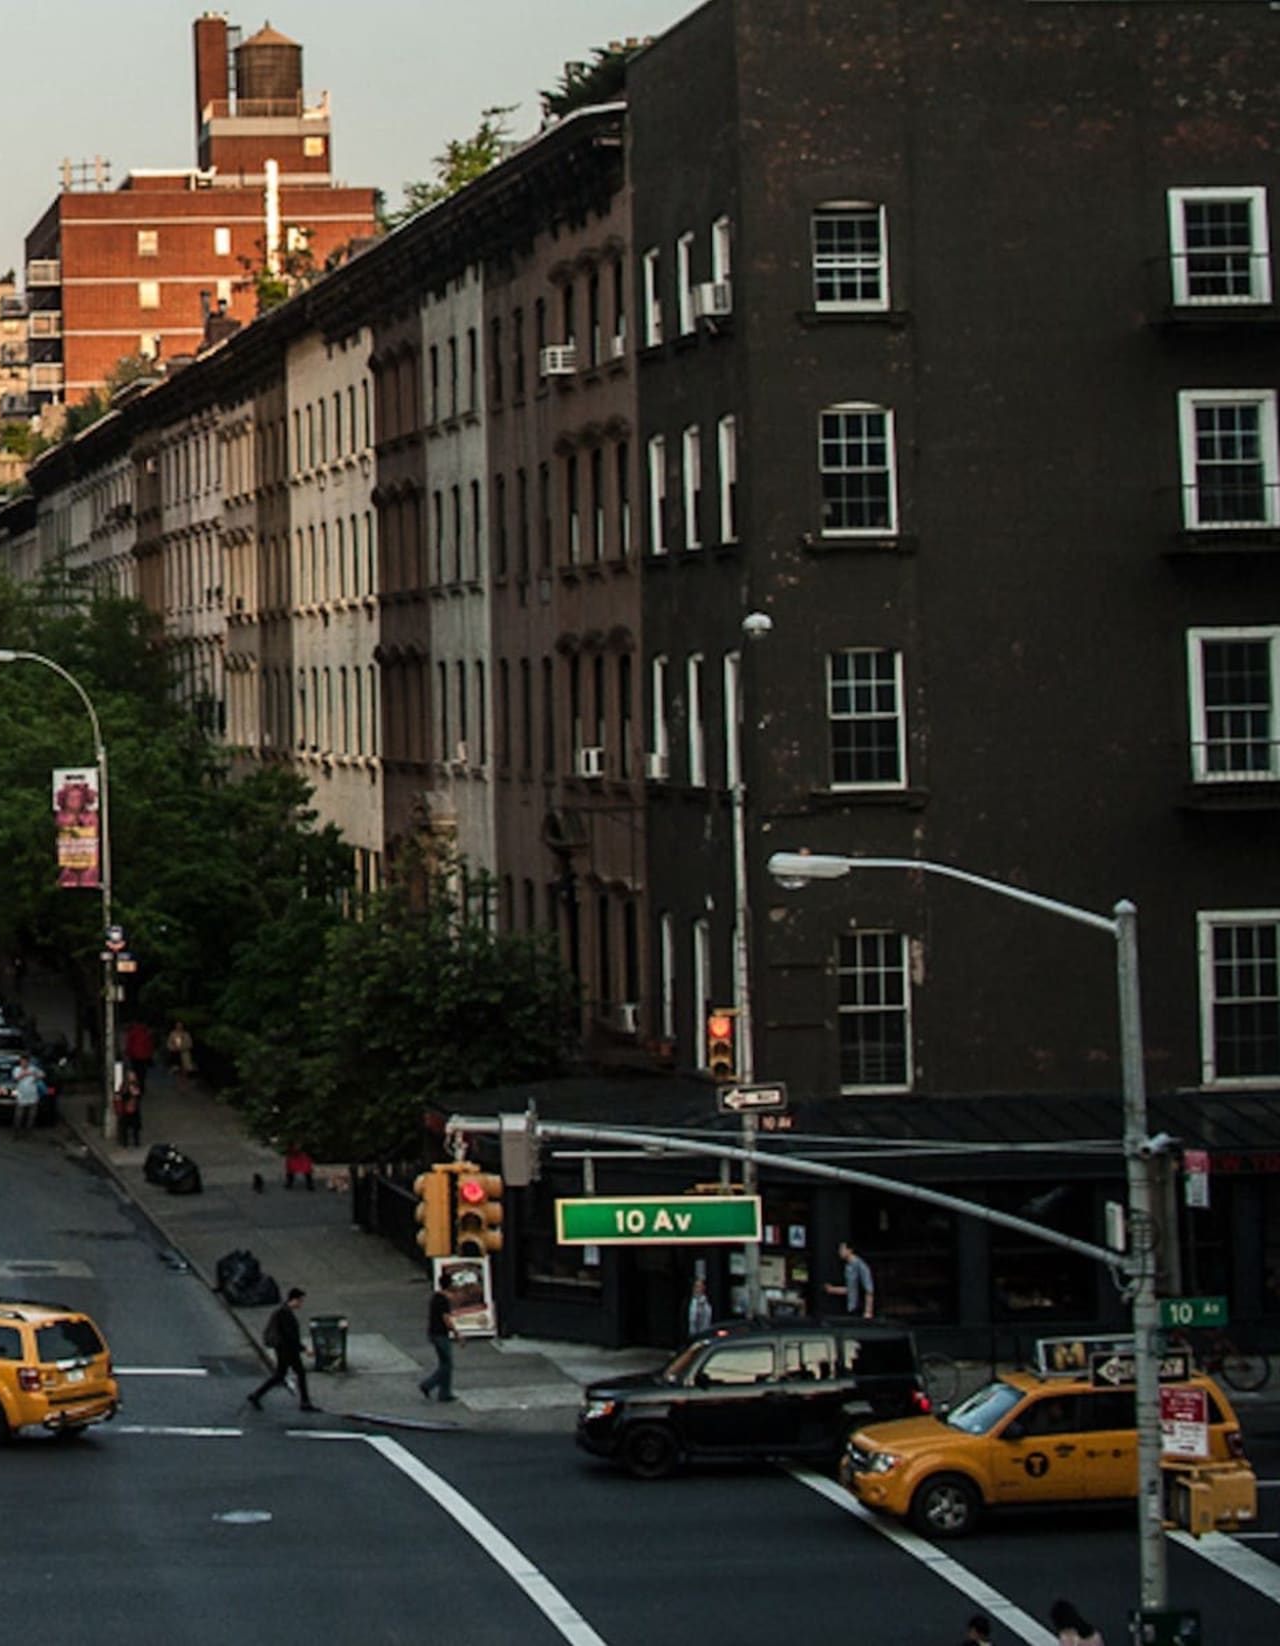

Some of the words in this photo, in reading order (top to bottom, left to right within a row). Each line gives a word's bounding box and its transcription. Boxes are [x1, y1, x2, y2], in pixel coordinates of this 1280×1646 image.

[615, 1209, 646, 1233] 10
[653, 1207, 692, 1232] Av
[1169, 1303, 1194, 1324] 10
